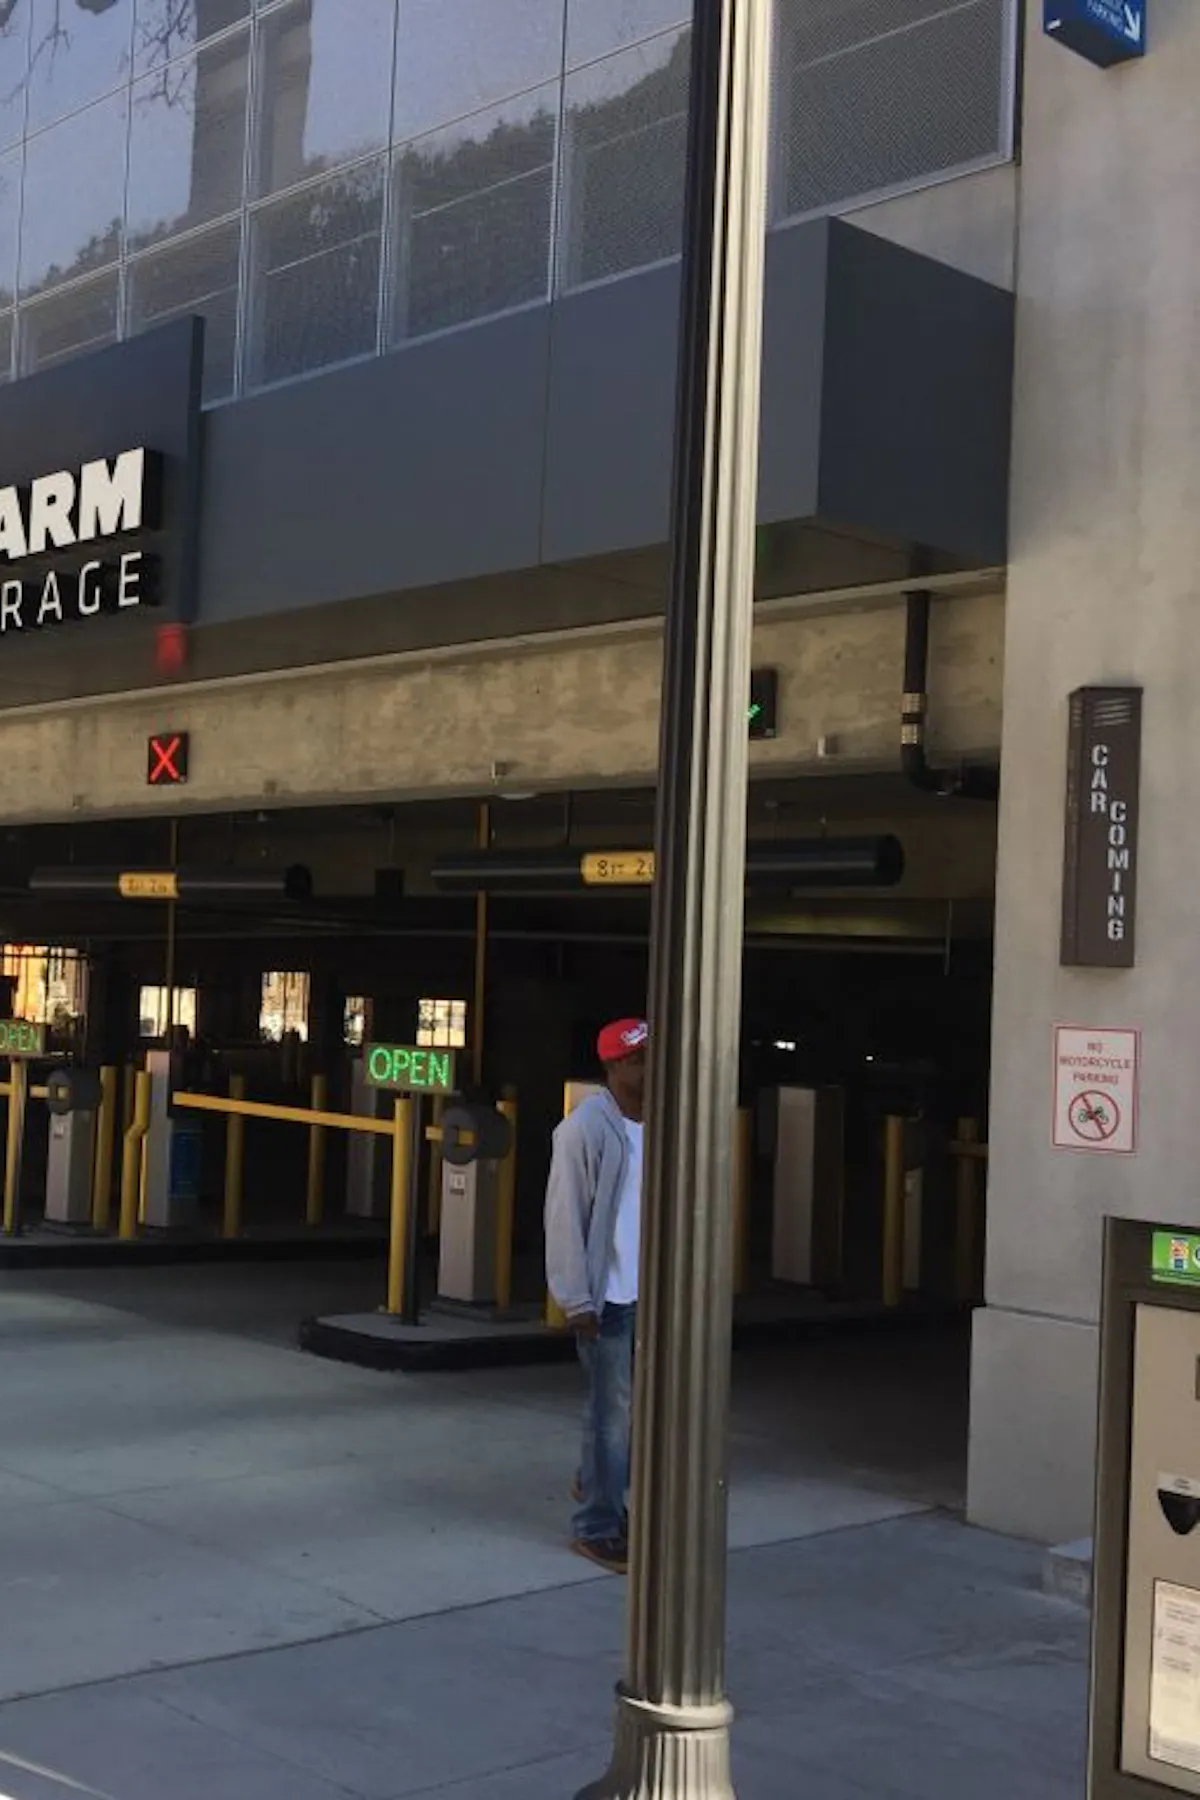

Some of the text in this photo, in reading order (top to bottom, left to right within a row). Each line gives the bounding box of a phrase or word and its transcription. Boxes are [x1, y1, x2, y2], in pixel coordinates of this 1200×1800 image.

[1090, 744, 1108, 813] CAR
[1107, 801, 1130, 940] COMING
[369, 1047, 450, 1087] OPEN
